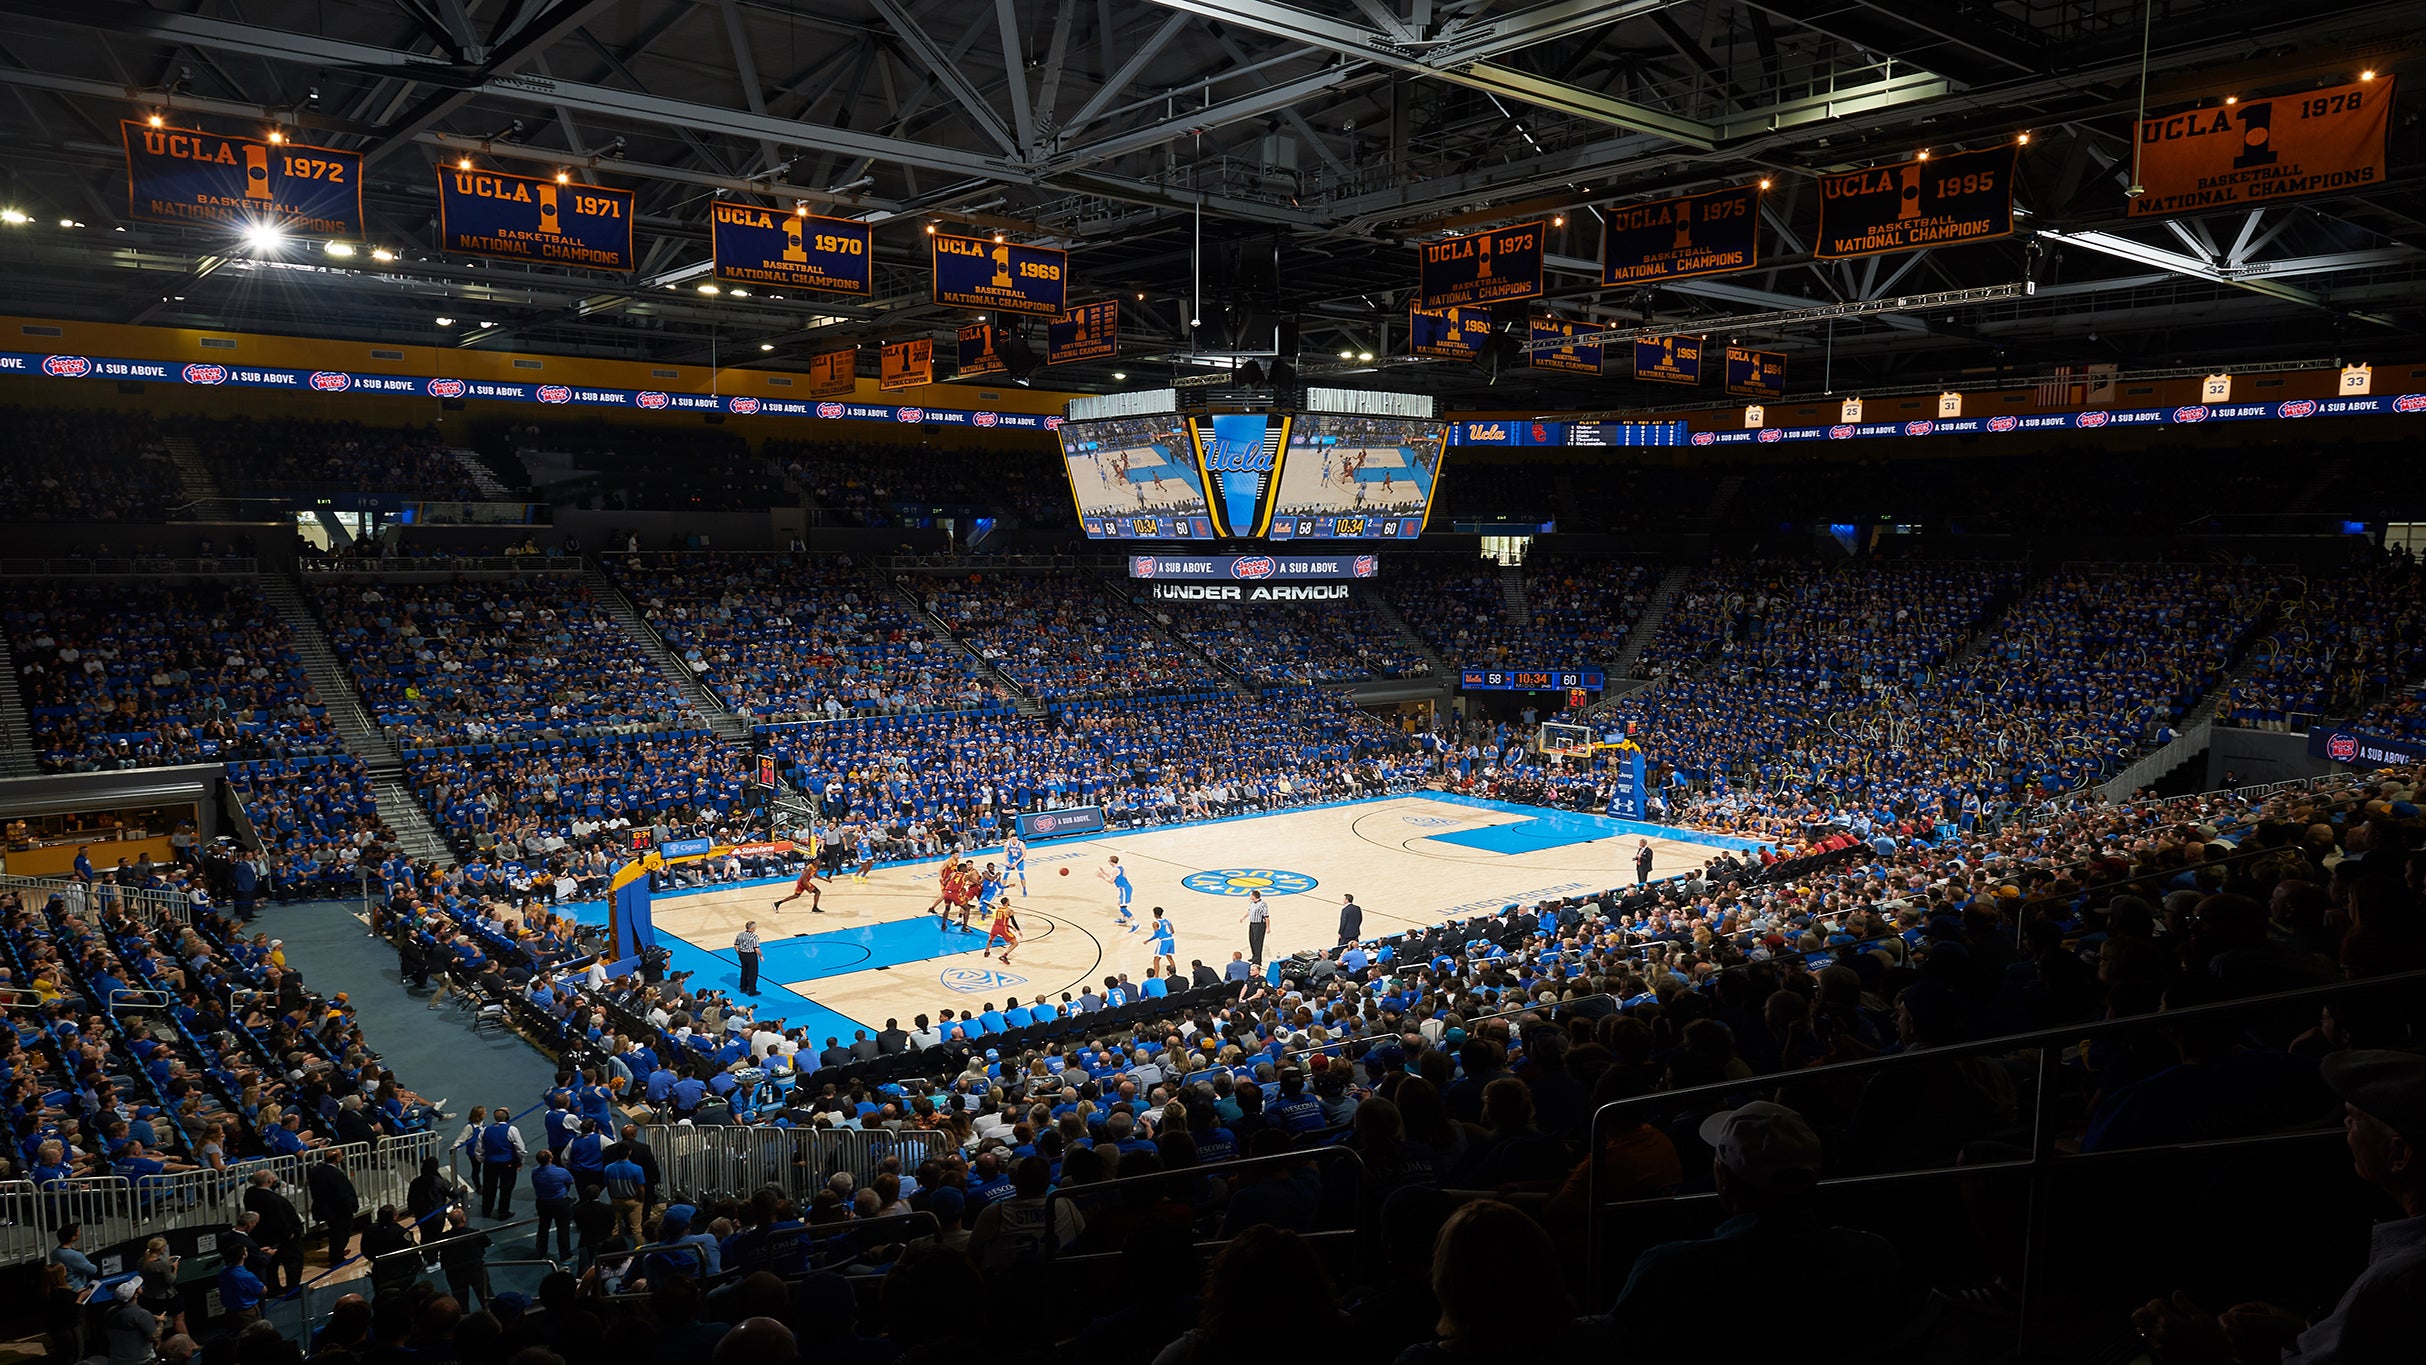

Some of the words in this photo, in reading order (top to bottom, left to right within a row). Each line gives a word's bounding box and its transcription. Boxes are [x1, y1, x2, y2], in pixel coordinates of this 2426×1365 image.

[2141, 110, 2232, 144] UCLA
[2233, 102, 2278, 169] 1
[2301, 92, 2363, 119] 1978
[144, 131, 237, 165] UCLA
[242, 144, 273, 200] 1
[284, 157, 344, 183] 1972
[2198, 165, 2303, 190] BASKETBALL
[1825, 171, 1893, 199] UCLA
[1898, 166, 1921, 219] 1
[1937, 171, 1995, 198] 1995
[2137, 189, 2238, 213] NATIONAL
[2249, 167, 2374, 197] CHAMPIONS
[197, 194, 303, 215] BASKETBALL
[455, 174, 532, 203] UCLA
[537, 185, 561, 234] 1
[576, 196, 620, 218] 1971
[1616, 206, 1672, 231] UCLA
[1673, 201, 1691, 248] 1
[1703, 198, 1746, 221] 1975
[1868, 216, 1956, 234] BASKETBALL
[498, 229, 584, 247] BASKETBALL
[717, 207, 773, 229] UCLA
[782, 217, 807, 262] 1
[815, 235, 862, 255] 1970
[1835, 232, 1903, 252] NATIONAL
[1910, 220, 1990, 242] CHAMPIONS
[460, 235, 531, 254] NATIONAL
[543, 244, 619, 264] CHAMPIONS
[1429, 241, 1474, 263] UCLA
[1477, 236, 1492, 278] 1
[1499, 234, 1533, 254] 1973
[1644, 246, 1712, 262] BASKETBALL
[763, 261, 824, 274] BASKETBALL
[937, 238, 984, 257] UCLA
[992, 246, 1012, 287] 1
[1020, 262, 1059, 280] 1969
[1615, 263, 1668, 279] NATIONAL
[1677, 252, 1742, 271] CHAMPIONS
[726, 266, 789, 281] NATIONAL
[792, 274, 859, 289] CHAMPIONS
[1452, 277, 1508, 291] BASKETBALL
[975, 286, 1026, 298] BASKETBALL
[1429, 291, 1472, 305] NATIONAL
[1479, 282, 1531, 298] CHAMPIONS
[944, 292, 997, 305] NATIONAL
[999, 298, 1055, 312] CHAMPIONS
[1533, 320, 1559, 332] UCLA
[959, 328, 981, 341] UCLA
[1677, 347, 1697, 359] 1965
[1729, 350, 1749, 361] UCLA
[96, 364, 103, 373] A
[106, 365, 127, 374] SUB
[131, 366, 167, 376] ABOVE.
[232, 372, 238, 380] A
[241, 372, 260, 382] SUB
[264, 374, 297, 384] ABOVE.
[2347, 377, 2364, 386] 33
[355, 379, 361, 388] A
[363, 379, 381, 389] SUB
[384, 381, 415, 391] ABOVE.
[469, 385, 475, 394] A
[477, 386, 494, 395] SUB
[497, 387, 524, 397] ABOVE.
[2209, 385, 2225, 394] 32
[575, 392, 580, 400] A
[582, 393, 598, 401] SUB
[600, 394, 626, 403] ABOVE.
[679, 398, 693, 406] SUB
[695, 400, 719, 408] ABOVE.
[1307, 387, 1344, 412] EDWIN
[1347, 390, 1356, 413] W
[1360, 391, 1394, 415] PAULEY
[1396, 393, 1433, 418] PAVILION
[784, 405, 807, 413] ABOVE.
[1945, 402, 1955, 410] 31
[2211, 409, 2217, 417] A
[2219, 408, 2235, 417] SUB
[2238, 407, 2266, 416] ABOVE.
[2319, 403, 2325, 412] A
[2327, 402, 2346, 412] SUB
[2348, 401, 2379, 411] ABOVE.
[2025, 419, 2040, 427] SUB
[2041, 418, 2065, 426] ABOVE.
[2118, 414, 2133, 422] SUB
[2135, 413, 2161, 421] ABOVE.
[1469, 424, 1505, 440] Ucla
[1202, 440, 1275, 471] Ucla
[1105, 523, 1116, 534] 58
[1133, 520, 1157, 533] 10:34
[1176, 522, 1188, 534] 60
[1299, 522, 1312, 534] 58
[1337, 520, 1364, 533] 10:34
[1384, 523, 1396, 534] 60
[1159, 563, 1164, 572] A
[1166, 563, 1180, 572] SUB
[1183, 563, 1214, 573] ABOVE.
[1236, 560, 1269, 569] Jersey
[1280, 563, 1286, 573] A
[1289, 563, 1308, 573] SUB
[1310, 562, 1339, 572] ABOVE.
[1164, 585, 1241, 599] UNDER
[1250, 585, 1349, 599] ARMOUR
[1489, 674, 1501, 684] 58
[1519, 674, 1547, 684] 10:34
[1564, 675, 1576, 685] 60
[1570, 697, 1584, 706] 21
[2360, 746, 2365, 758] A
[2367, 748, 2382, 761] SUB
[680, 843, 701, 851] Cigna
[1282, 1102, 1315, 1114] WESCOM
[1199, 1143, 1225, 1154] ESCOM
